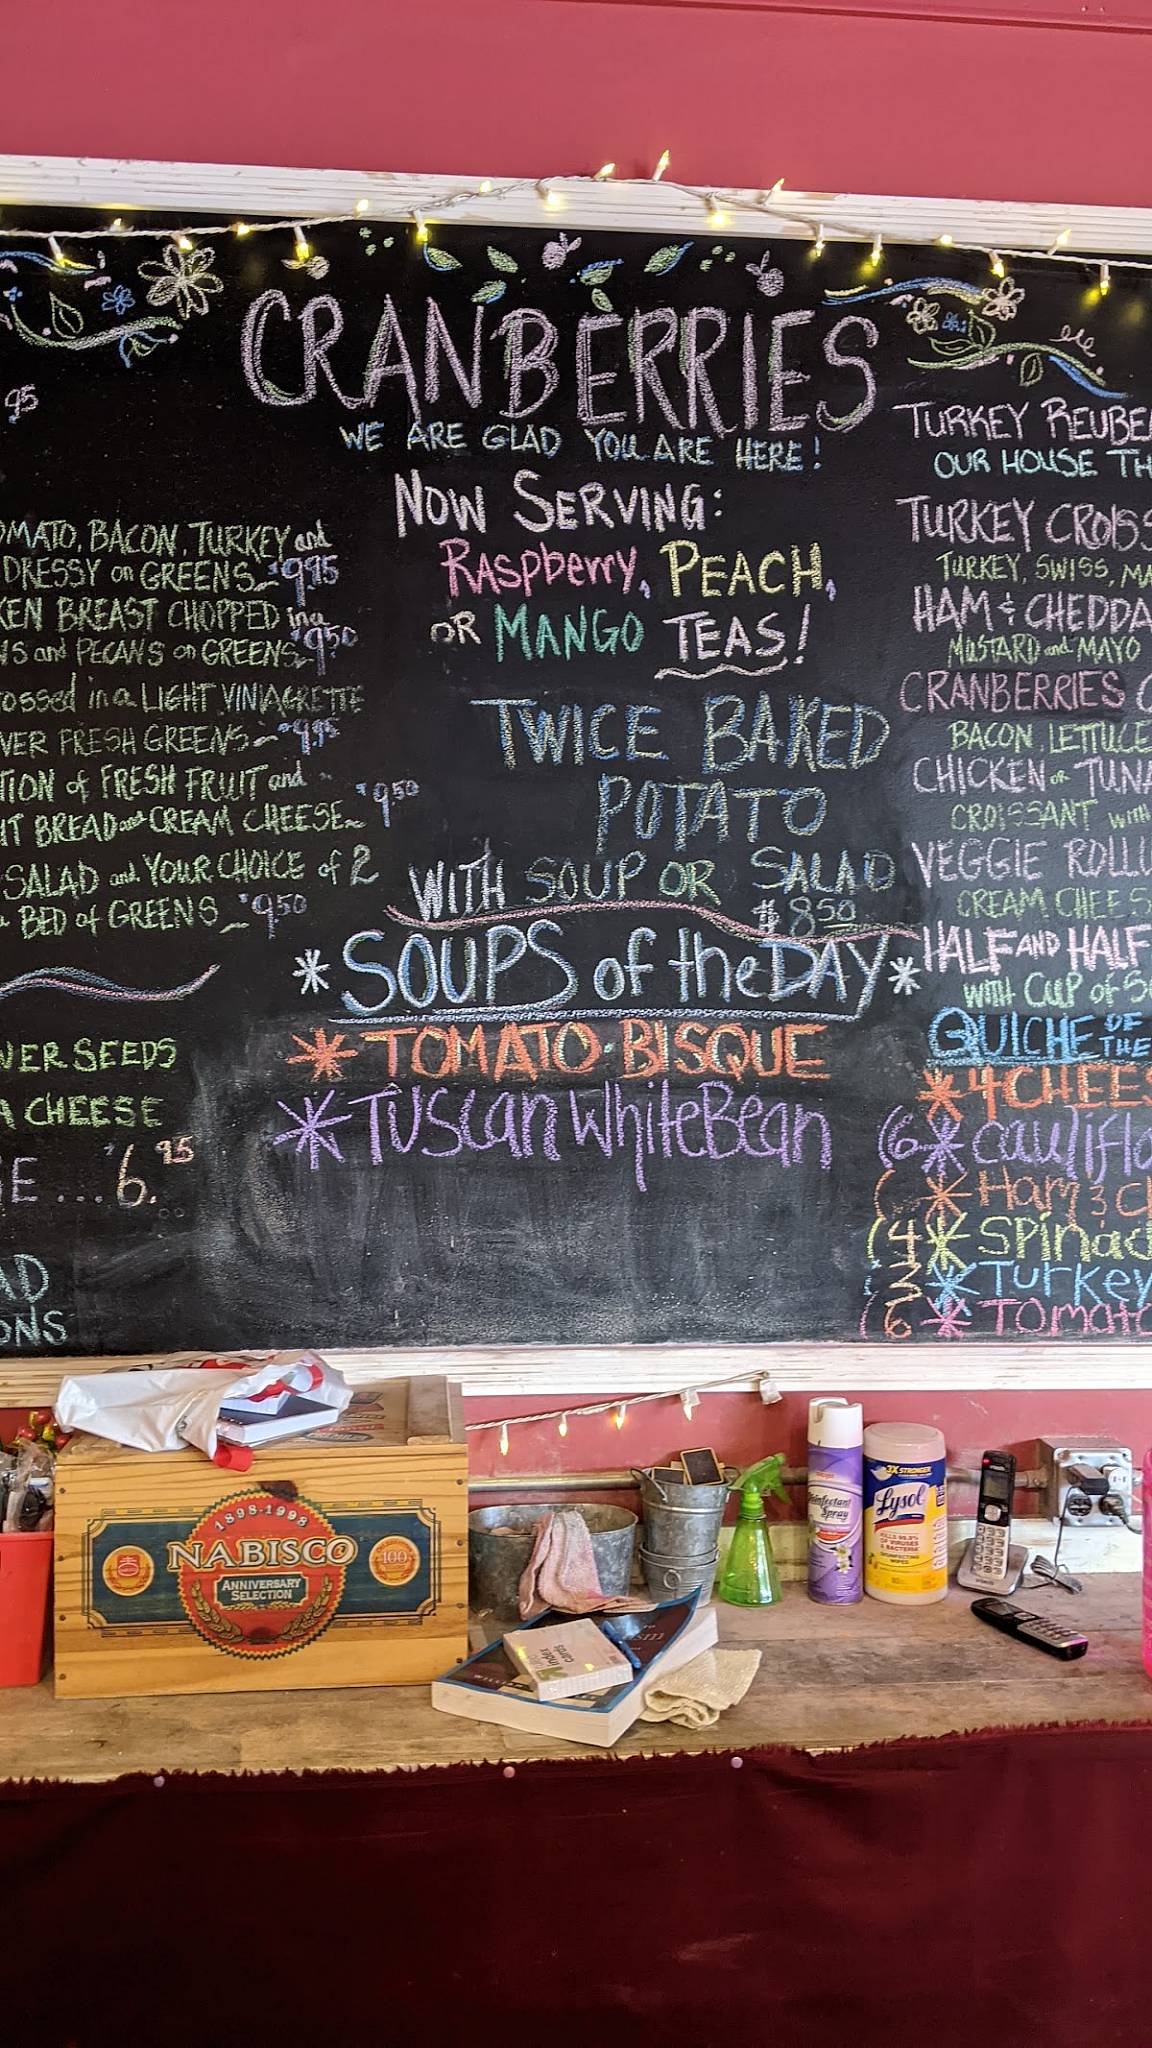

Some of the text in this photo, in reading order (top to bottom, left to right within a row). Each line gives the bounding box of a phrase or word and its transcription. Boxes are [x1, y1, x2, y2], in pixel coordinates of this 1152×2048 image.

[240, 287, 880, 438] CRANBERRIES
[891, 401, 1030, 441] TURKEY
[338, 423, 385, 453] WE
[406, 421, 468, 452] ARE
[483, 424, 561, 460] GLAD
[585, 428, 650, 463] YOU
[650, 435, 715, 466] ARE
[934, 448, 991, 479] OUR
[1002, 448, 1098, 478] HOUSE
[88, 518, 188, 557] BACON,
[188, 520, 292, 563] TURKEY
[294, 519, 333, 552] and
[895, 495, 1036, 552] TURKEY
[3, 555, 102, 590] DRESSY
[110, 563, 135, 584] on
[139, 560, 256, 593] GREENS
[55, 596, 160, 633] BREAST
[167, 599, 281, 632] CHOPPED
[913, 583, 1152, 634] HAM & CHEDDA
[33, 637, 67, 663] and
[76, 636, 166, 668] PECANS
[173, 643, 197, 661] on
[201, 637, 300, 669] GREENS
[494, 603, 645, 663] MANGO
[947, 632, 1142, 668] MUSTARD and MAYO
[141, 682, 217, 713] LIGHT
[899, 669, 1126, 713] CRANBERRIES
[58, 726, 138, 757] FRESH
[143, 723, 250, 757] GREENS
[469, 690, 891, 775] TWICE BAKED
[65, 769, 90, 804] of
[100, 763, 176, 801] FRESH
[185, 763, 270, 802] FRUIT
[268, 760, 308, 792] and
[913, 753, 1046, 796] CHICKEN
[35, 811, 118, 848] BREAD
[148, 804, 234, 837] CREAM
[242, 800, 344, 836] CHEESE
[596, 773, 828, 855] POTATO
[951, 798, 1099, 832] CROISSANT
[3, 843, 380, 900] SALAD and YOUR CHOICE of 2
[407, 839, 896, 922] WITH SOUP OR SALAD
[911, 837, 1049, 889] VEGGIE
[18, 904, 68, 940] BED
[75, 904, 102, 938] of
[107, 896, 219, 930] GREENS
[956, 887, 1050, 922] CREAM
[341, 919, 893, 1017] SOUPS of the DAY
[922, 920, 1152, 976] HALF AND HALF
[928, 1006, 1144, 1060] QUICHE OF
[1098, 1035, 1152, 1058] THE
[72, 1037, 178, 1072] SEEDS
[24, 1091, 164, 1128] CHEESE
[213, 1503, 310, 1533] 1898-1998
[820, 1504, 849, 1521] Spray
[876, 1484, 927, 1519] Lysol
[167, 1535, 359, 1573] NABISCO
[383, 1551, 408, 1564] 100
[221, 1577, 302, 1591] ANNIVERSARY
[231, 1590, 293, 1602] SELECTION
